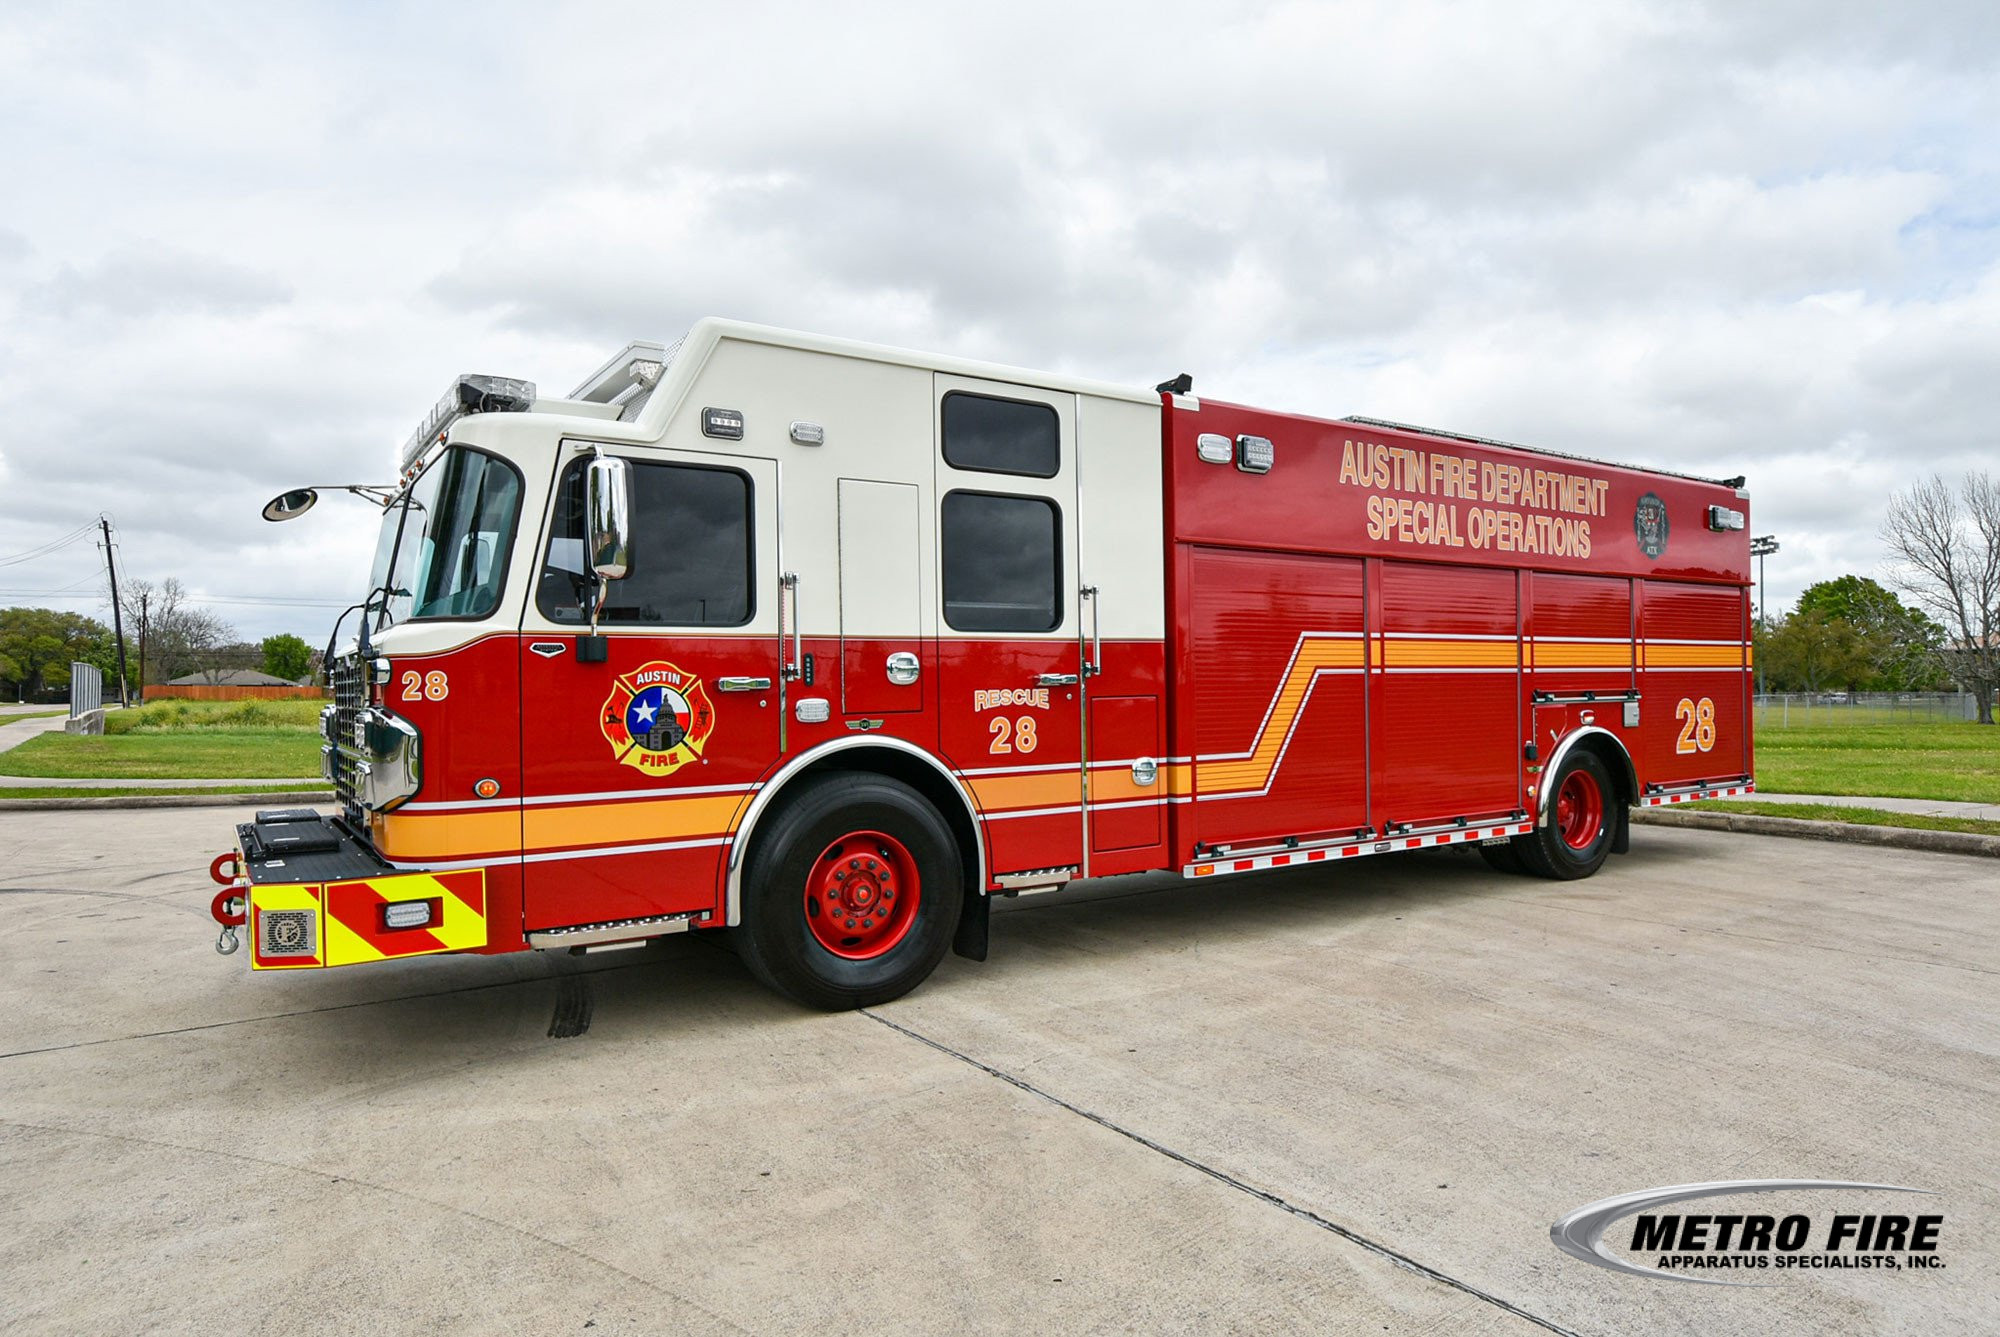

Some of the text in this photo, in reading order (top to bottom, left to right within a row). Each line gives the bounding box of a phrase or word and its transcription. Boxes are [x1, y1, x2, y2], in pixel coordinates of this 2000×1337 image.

[1339, 439, 1609, 517] AUSTIN FIRE DEPARTMENT
[1366, 495, 1591, 559] SPECIAL OPERATIONS
[401, 670, 449, 702] 28
[636, 670, 681, 685] AUSTIN
[974, 688, 1050, 712] RESCUE
[989, 715, 1038, 755] 28
[1675, 697, 1716, 755] 28
[639, 752, 680, 767] FIRE
